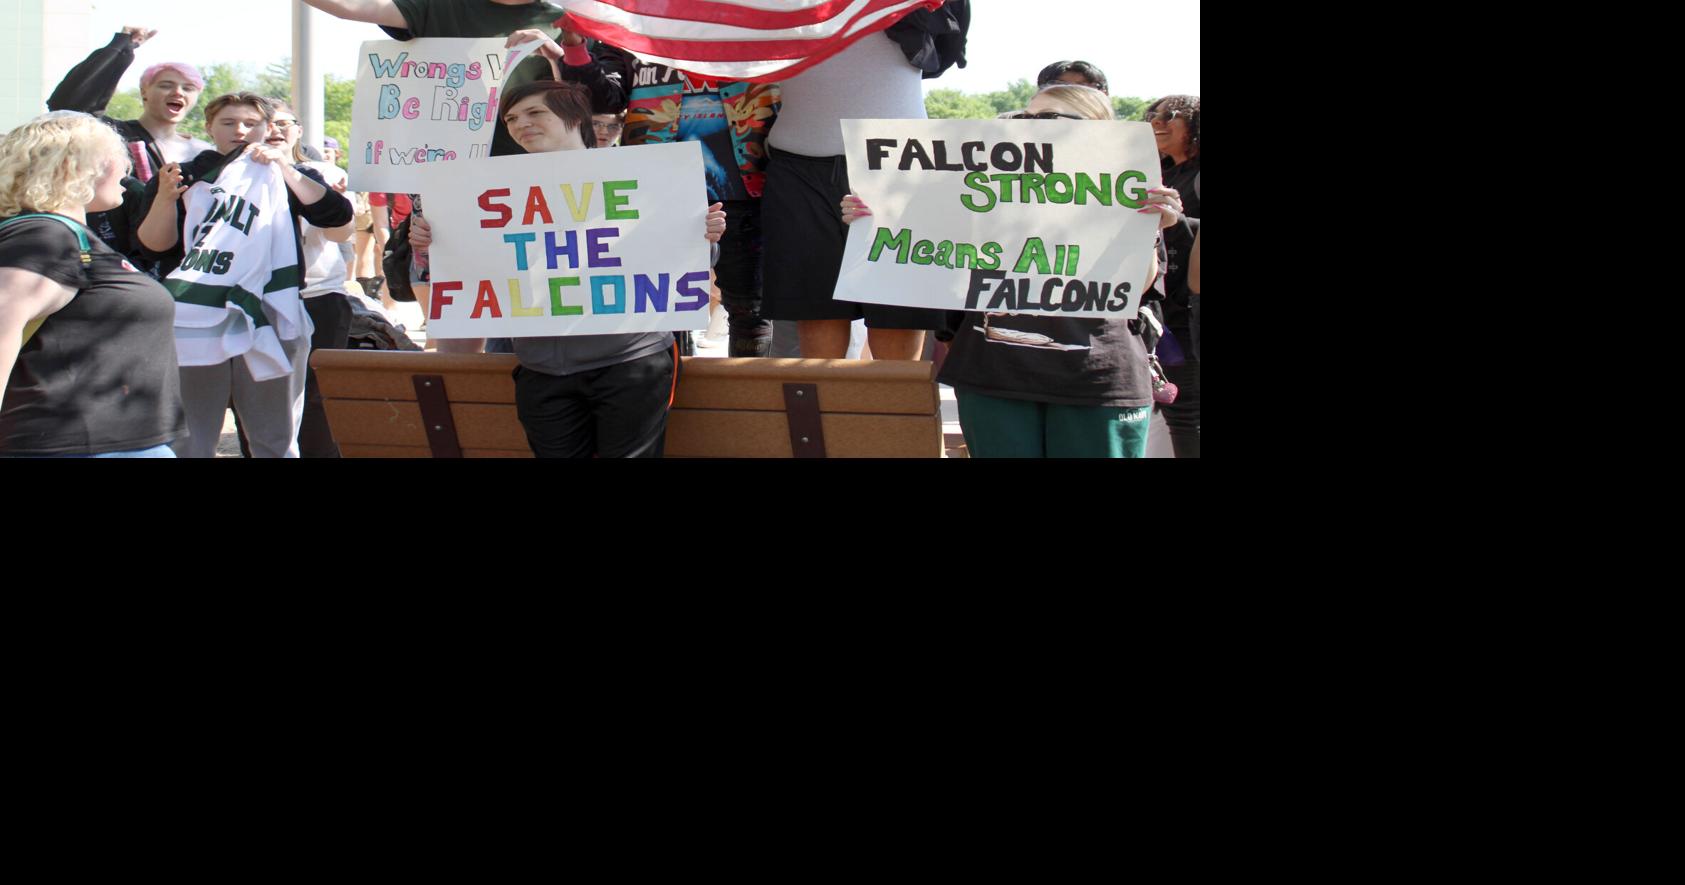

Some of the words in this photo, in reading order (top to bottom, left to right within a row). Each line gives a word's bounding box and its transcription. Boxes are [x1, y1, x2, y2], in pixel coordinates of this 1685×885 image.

[369, 52, 482, 88] Wrongs
[378, 84, 420, 120] Be
[366, 140, 384, 164] if
[866, 138, 1054, 173] FALCON
[478, 180, 639, 228] SAVE
[960, 170, 1150, 213] STRONG
[503, 227, 622, 271] THE
[868, 227, 1003, 270] Means
[1012, 236, 1081, 276] All
[429, 271, 710, 319] FALCONS
[964, 268, 1132, 312] FALCONS
